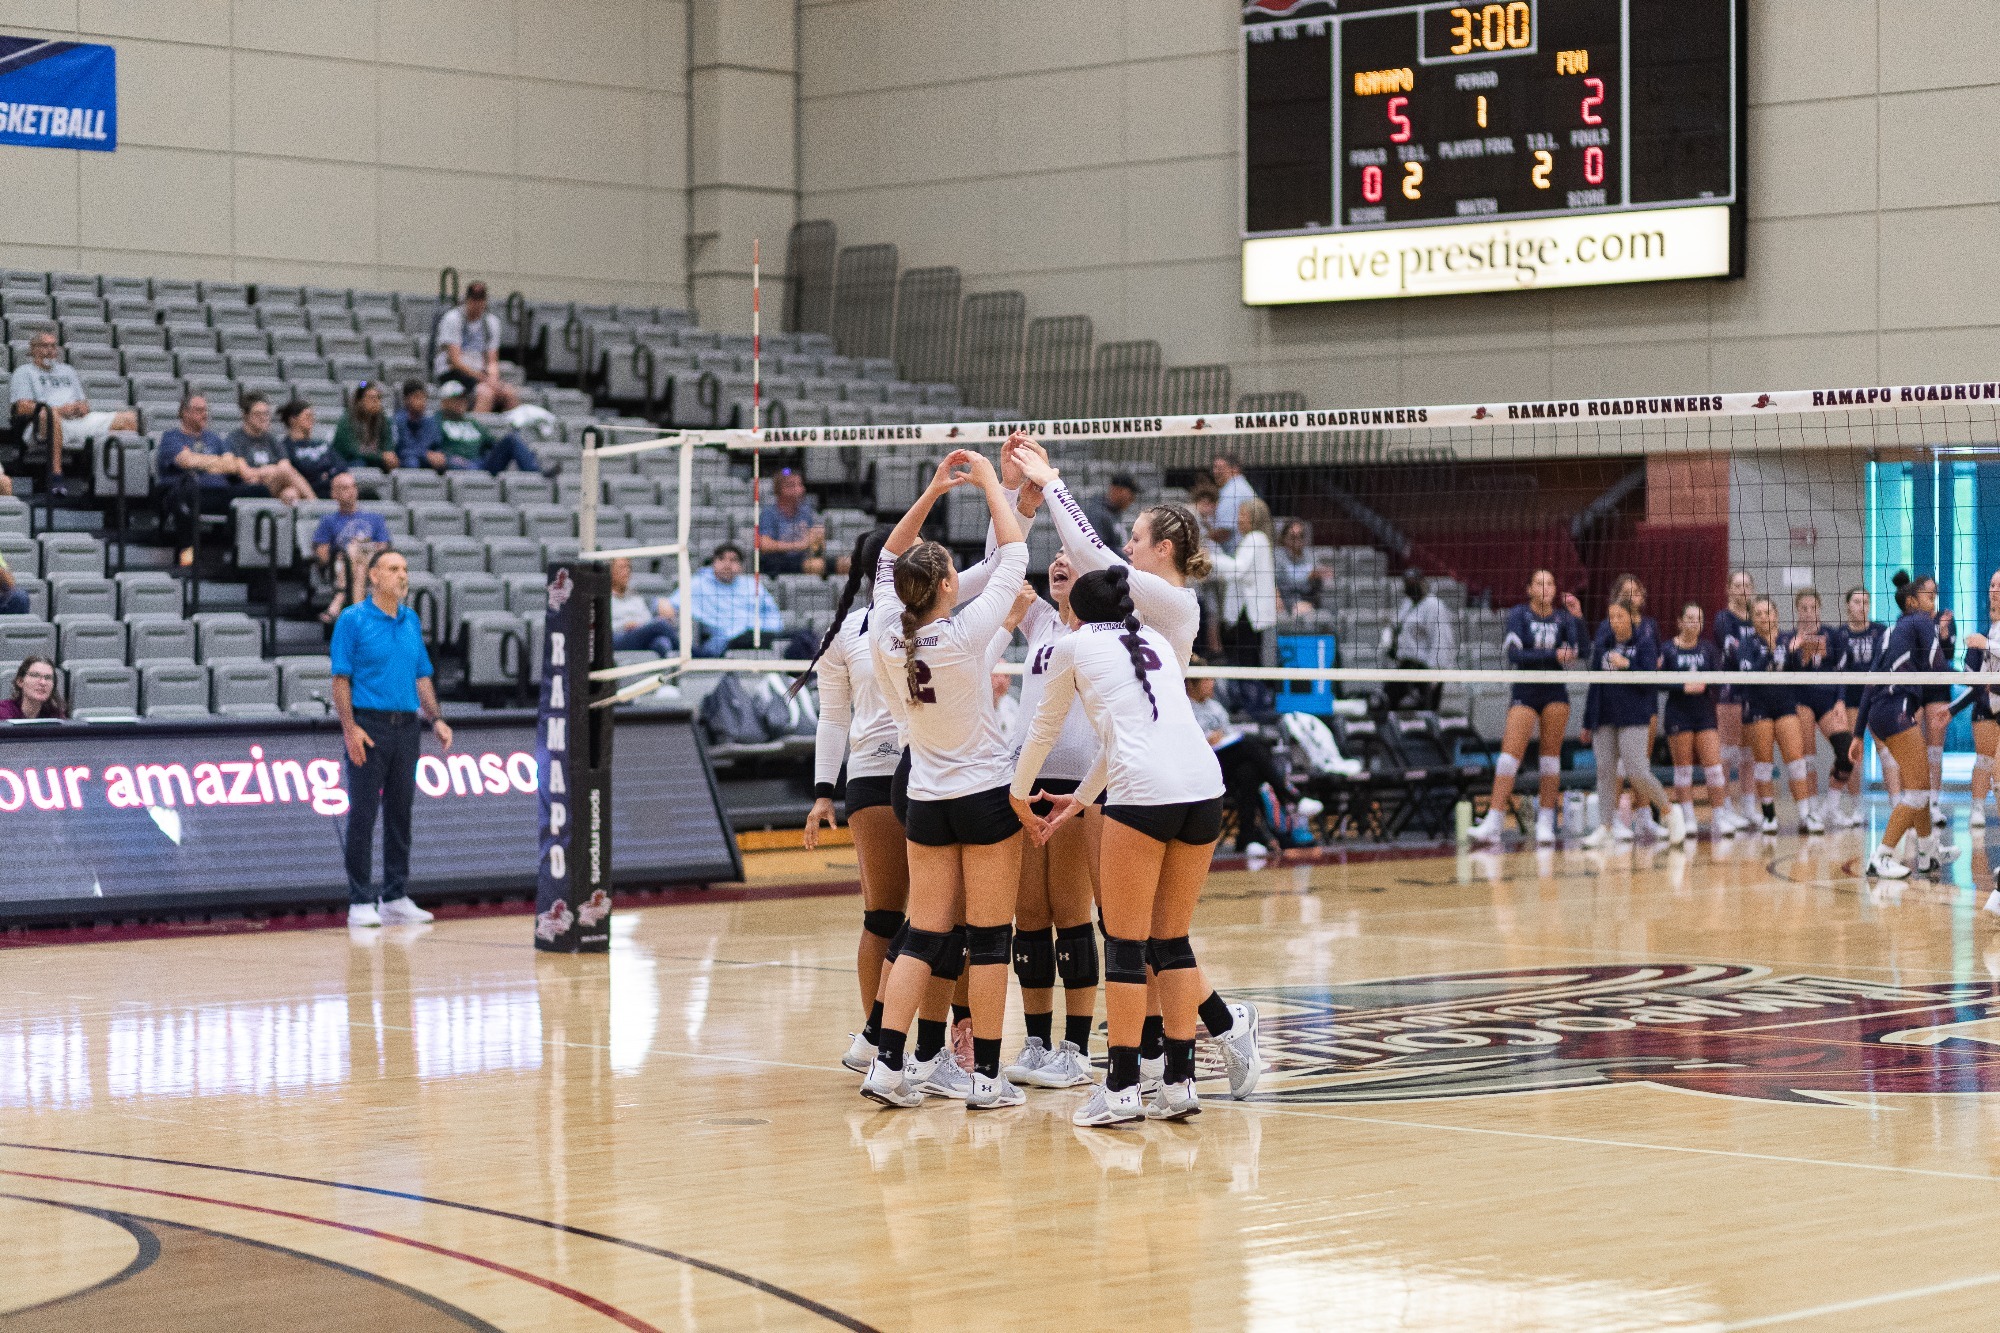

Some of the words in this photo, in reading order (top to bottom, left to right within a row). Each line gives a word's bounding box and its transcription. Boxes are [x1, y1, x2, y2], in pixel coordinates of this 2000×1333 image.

[1450, 2, 1530, 55] 3:00
[1387, 96, 1411, 143] 5
[1477, 95, 1488, 129] 1
[1581, 77, 1605, 125] 2
[1362, 165, 1383, 203] 0
[1402, 161, 1424, 200] 2
[1531, 150, 1553, 189] 2
[1583, 146, 1604, 184] 0
[1508, 402, 1580, 419] RAMAPO
[1588, 396, 1723, 416] ROADRUNNERS
[1812, 387, 1892, 406] RAMAPO
[1901, 383, 2000, 402] ROADRUN
[764, 429, 818, 443] RAMAPO
[823, 426, 923, 442] ROADRUNNERS
[1053, 418, 1163, 436] ROADRUNNERS
[1235, 413, 1299, 429] RAMAPO
[1306, 409, 1428, 427] ROADRUNNERS
[903, 659, 937, 703] 2
[546, 632, 567, 880] RAMAPO
[0, 765, 90, 812] our
[103, 744, 350, 816] amazing
